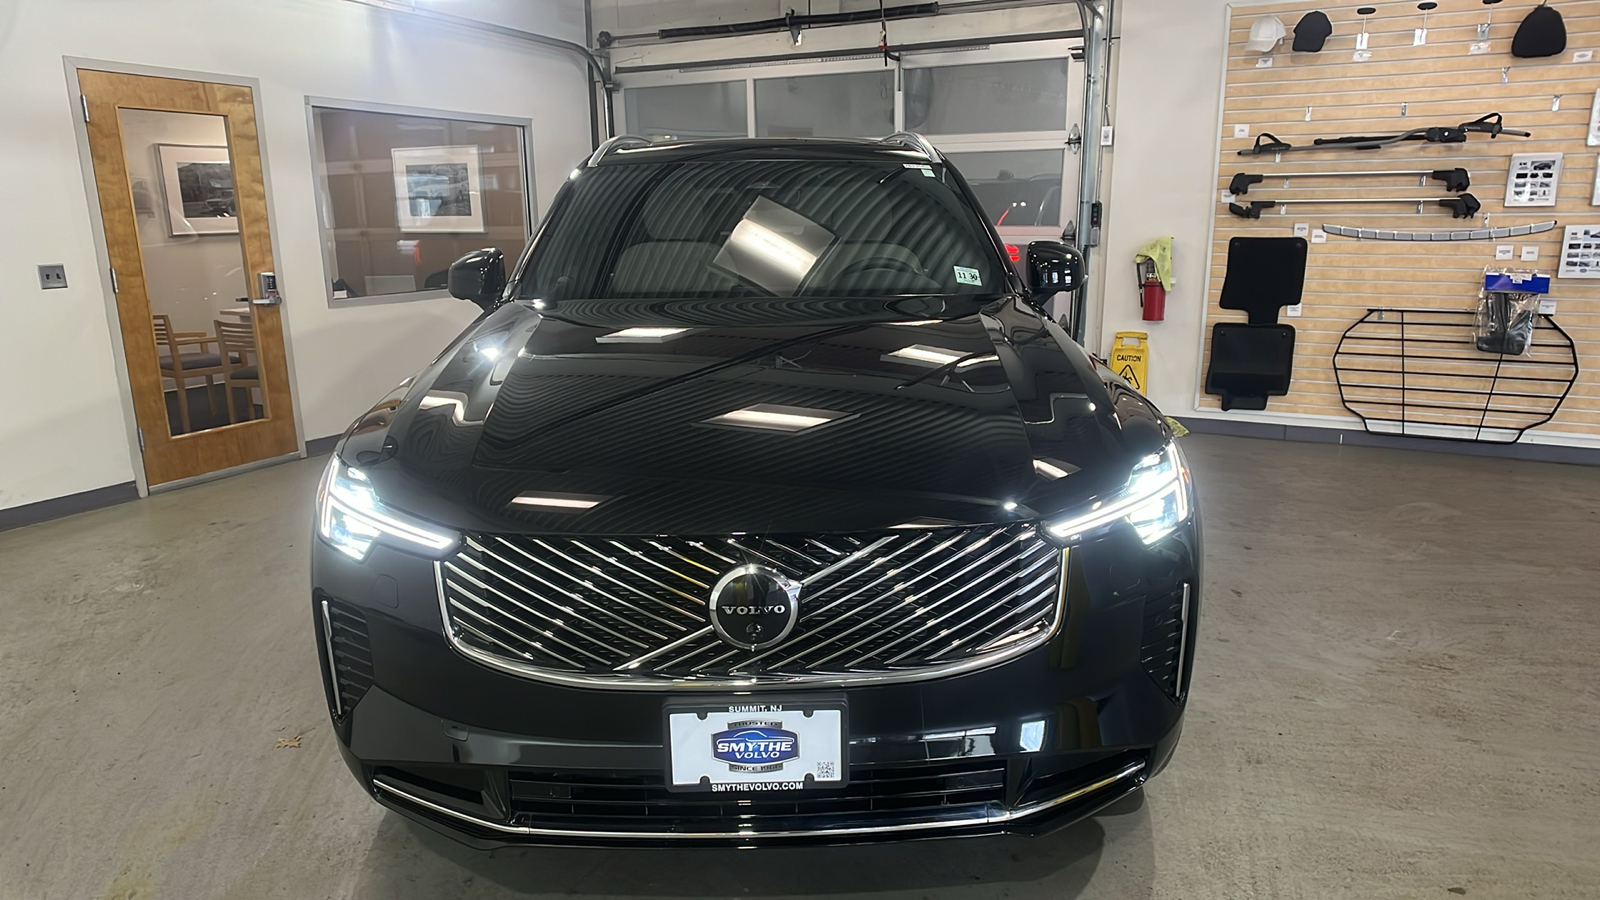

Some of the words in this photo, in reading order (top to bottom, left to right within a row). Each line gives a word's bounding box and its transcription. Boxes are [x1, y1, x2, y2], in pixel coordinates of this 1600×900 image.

[721, 605, 786, 615] VOLVO
[770, 704, 782, 712] NJ
[717, 741, 793, 752] SMYTHE
[735, 751, 780, 759] VOLVO
[711, 781, 804, 792] SMYTHEVOLVO.COM
